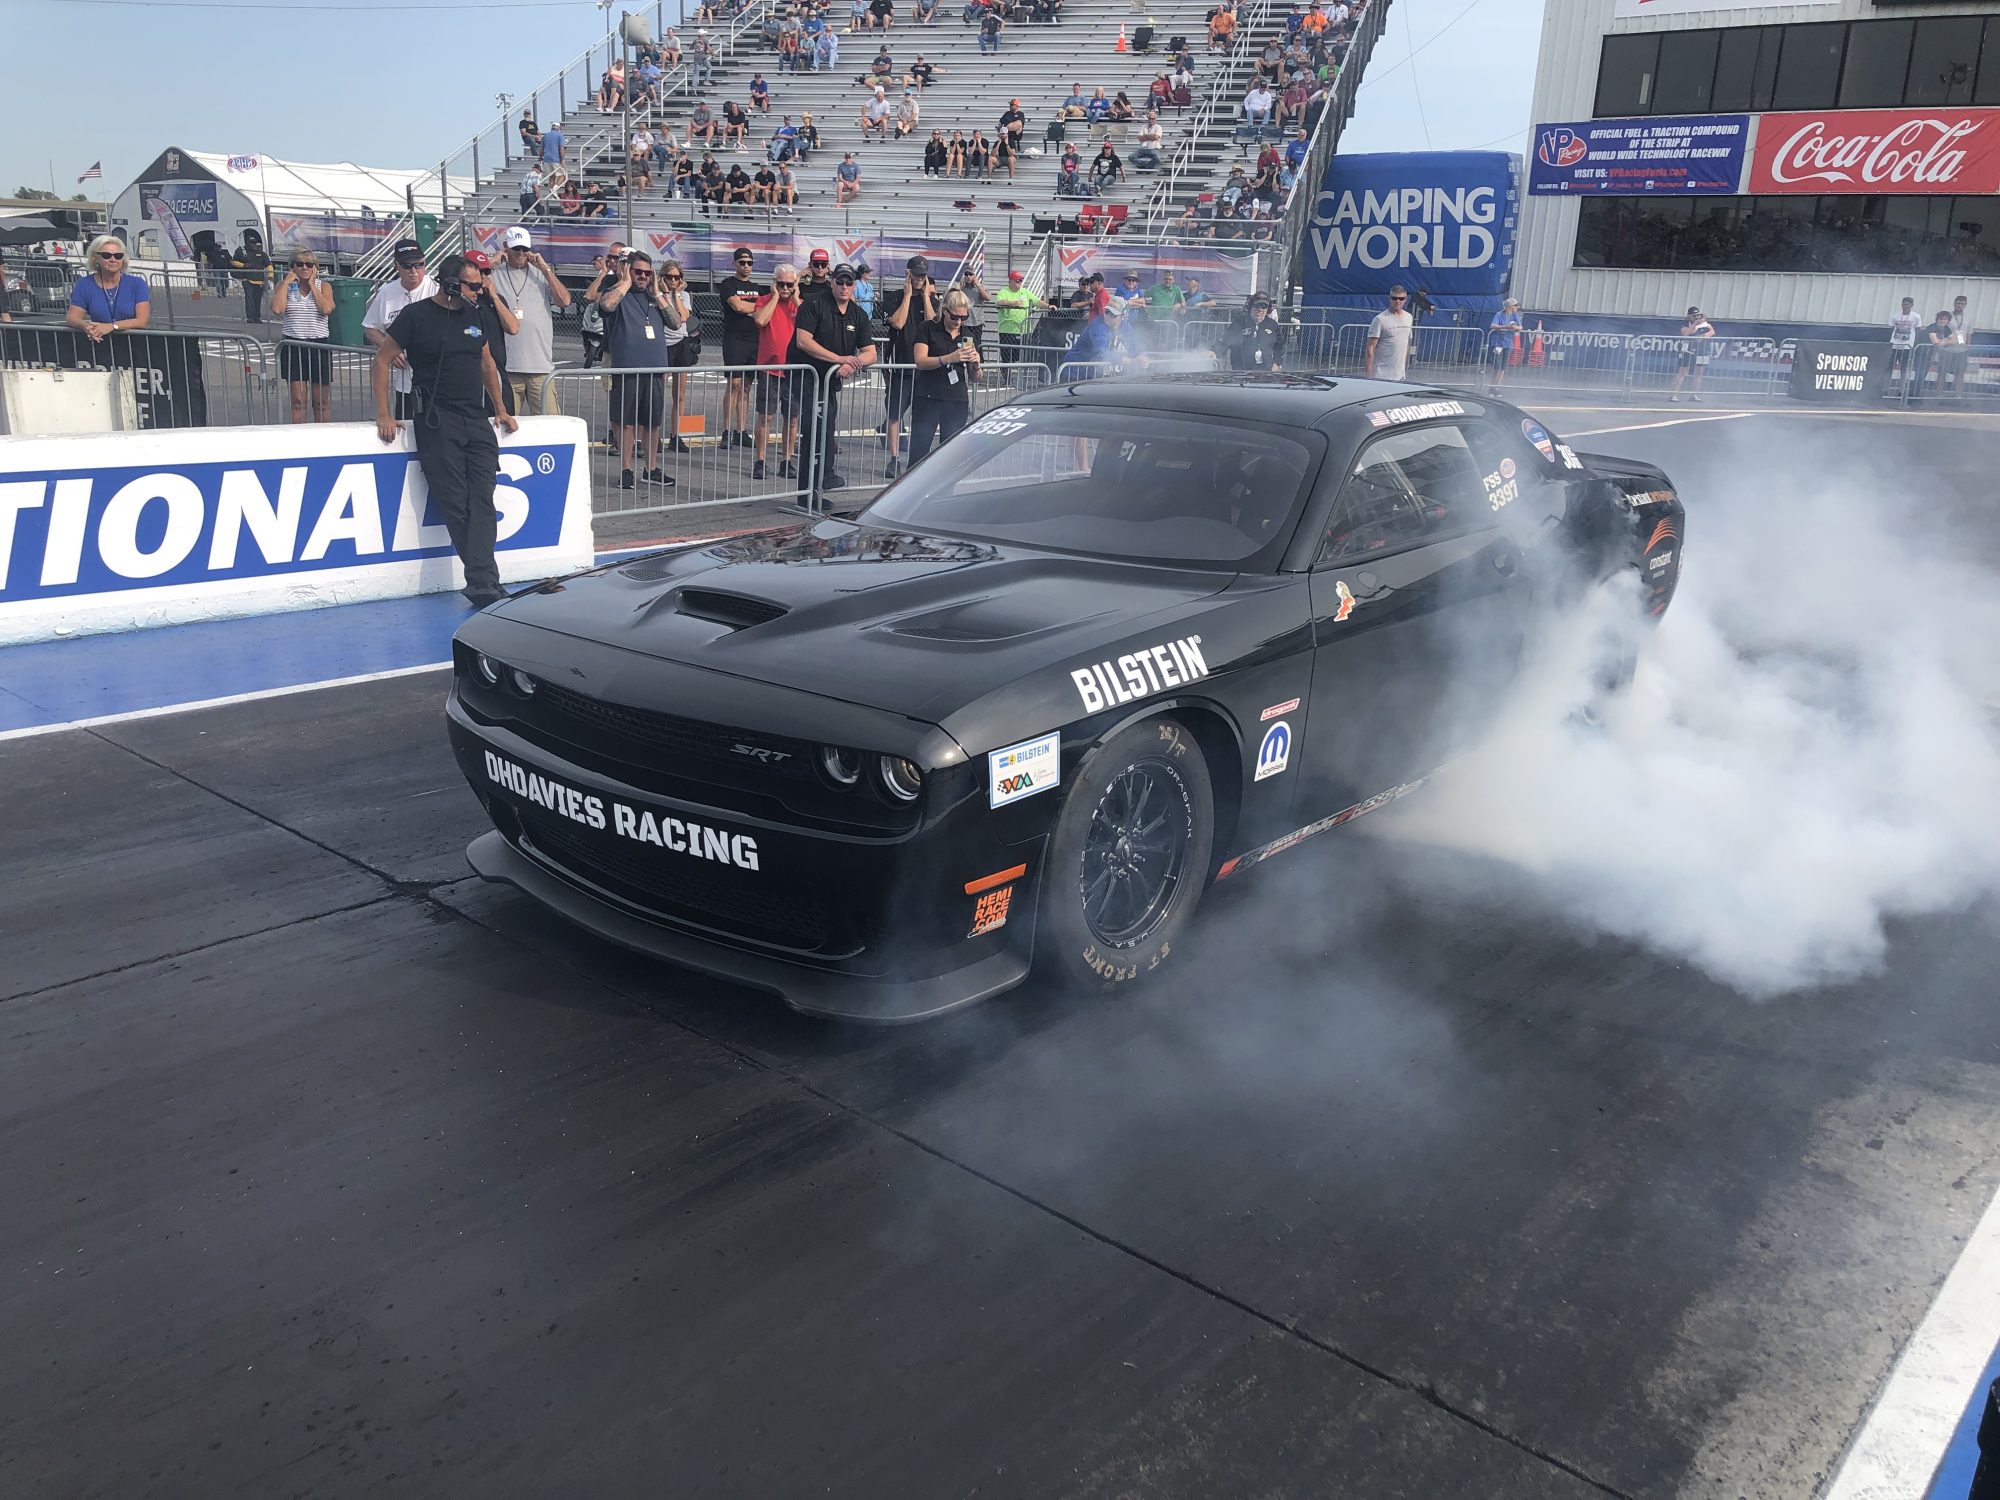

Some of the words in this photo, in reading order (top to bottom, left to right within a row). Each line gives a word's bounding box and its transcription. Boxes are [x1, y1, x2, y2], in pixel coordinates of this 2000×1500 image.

[1590, 129, 1623, 140] OFFICIAL
[1624, 128, 1643, 138] FUEL
[1643, 129, 1649, 138] &
[1650, 127, 1690, 137] TRACTION
[1691, 124, 1740, 136] COMPOUND
[1629, 139, 1640, 149] OF
[1641, 139, 1655, 149] THE
[1655, 138, 1681, 148] STRIP
[1681, 137, 1692, 147] AT
[1542, 127, 1575, 166] VP
[1588, 151, 1616, 161] WORLD
[1617, 150, 1639, 160] WIDE
[1639, 149, 1690, 160] TECHNOLOGY
[1690, 147, 1731, 158] RACEWAY
[1771, 118, 1985, 184] Coca-Cola
[1574, 169, 1594, 179] VISIT
[1595, 168, 1608, 178] US:
[188, 199, 214, 214] FANS
[1310, 186, 1496, 227] CAMPING
[1310, 225, 1495, 270] WORLD
[1578, 331, 1620, 349] Wide
[1625, 336, 1726, 359] Technoy
[1817, 352, 1869, 372] SPONSOR
[1815, 374, 1864, 391] VIEWING
[1386, 401, 1454, 424] @DHDAVIES
[1483, 471, 1501, 492] FSS
[1489, 479, 1519, 511] 3397
[1071, 637, 1209, 714] BILSTEIN
[730, 743, 792, 763] SRT
[1016, 743, 1050, 763] BILSTEIN
[1258, 763, 1285, 778] MOPAR
[484, 750, 606, 831] DHDAVIES
[613, 803, 760, 872] RACING
[1167, 766, 1192, 839] DRAGPAK
[976, 886, 1013, 910] HEMI
[973, 898, 1010, 922] RACE
[1082, 944, 1137, 982] FRONT
